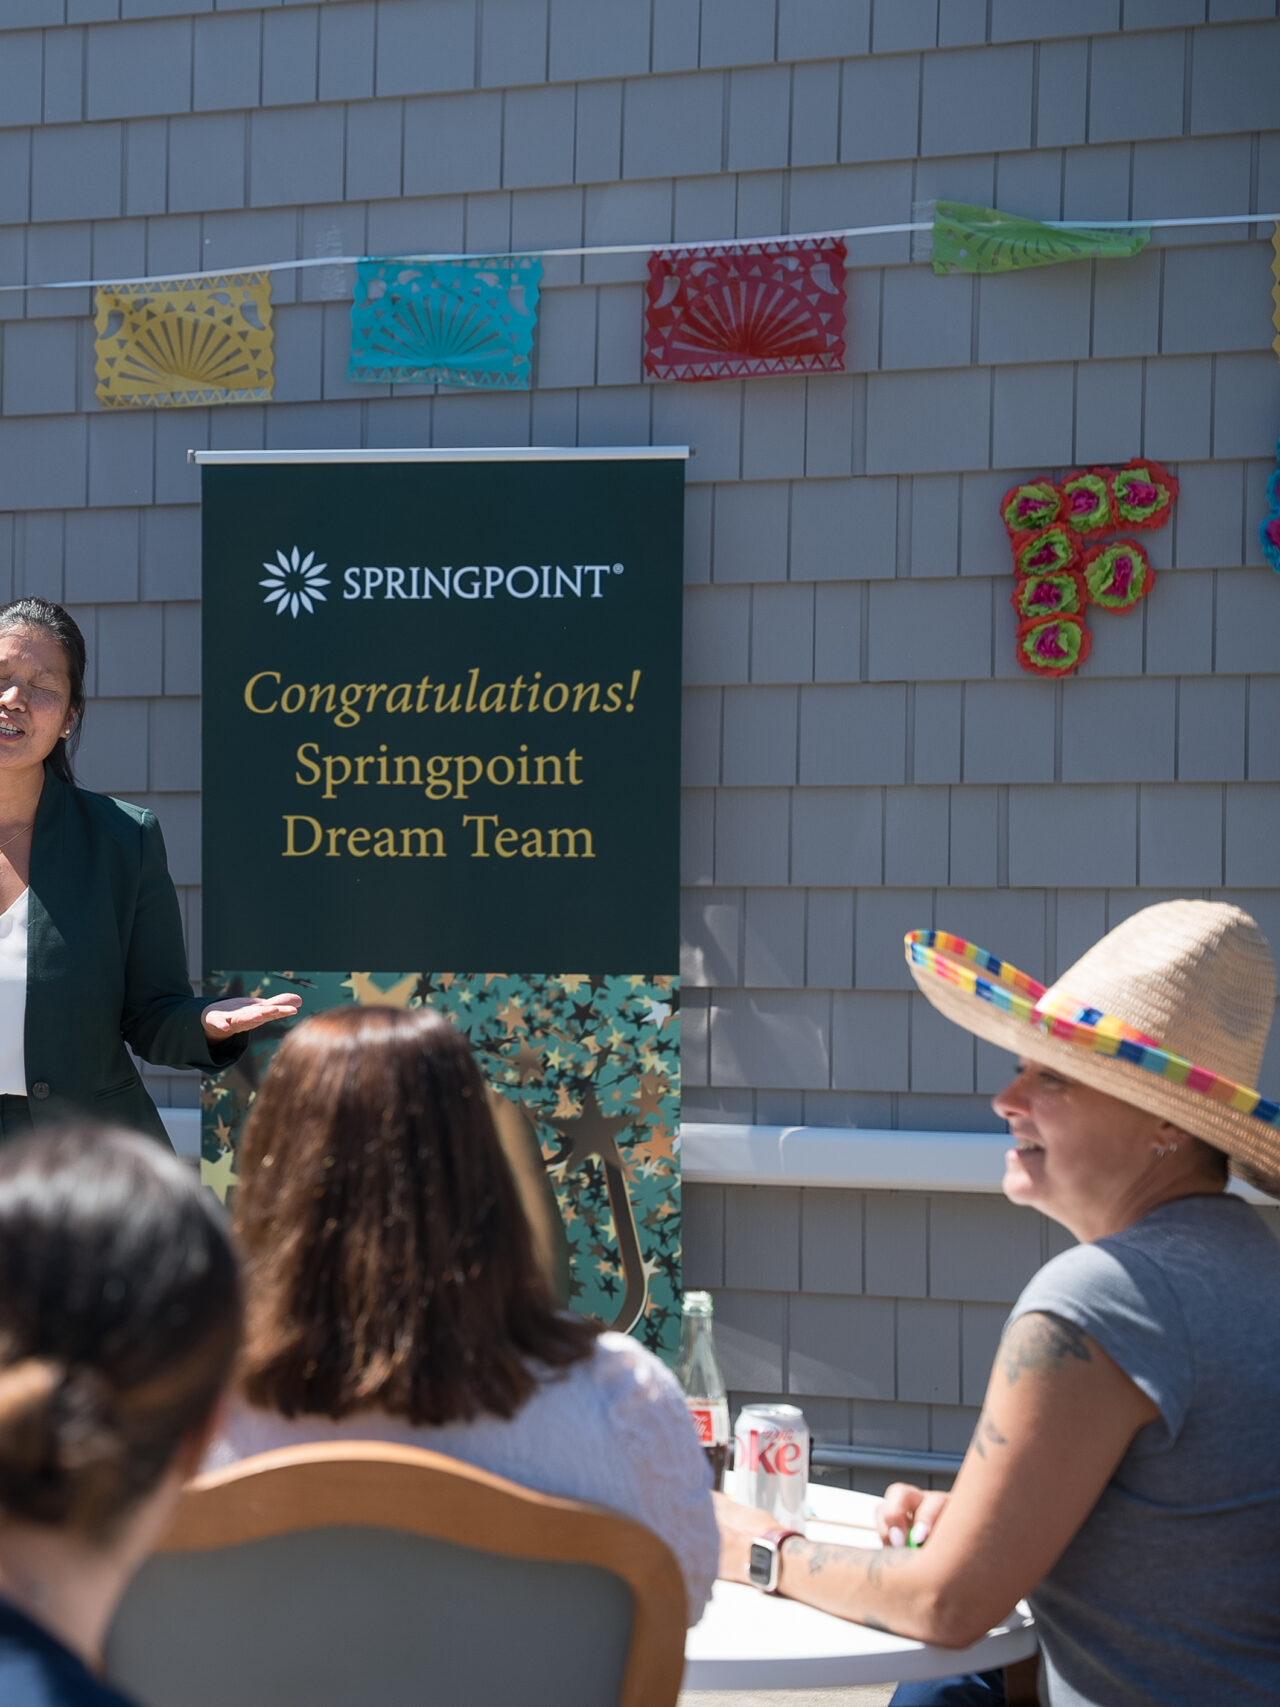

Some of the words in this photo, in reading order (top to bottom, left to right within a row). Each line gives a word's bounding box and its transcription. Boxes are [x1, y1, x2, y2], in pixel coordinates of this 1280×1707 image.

[245, 667, 641, 727] Congratulations!
[296, 743, 583, 800] Springpoint
[282, 816, 446, 857] Dream
[463, 815, 595, 857] Team
